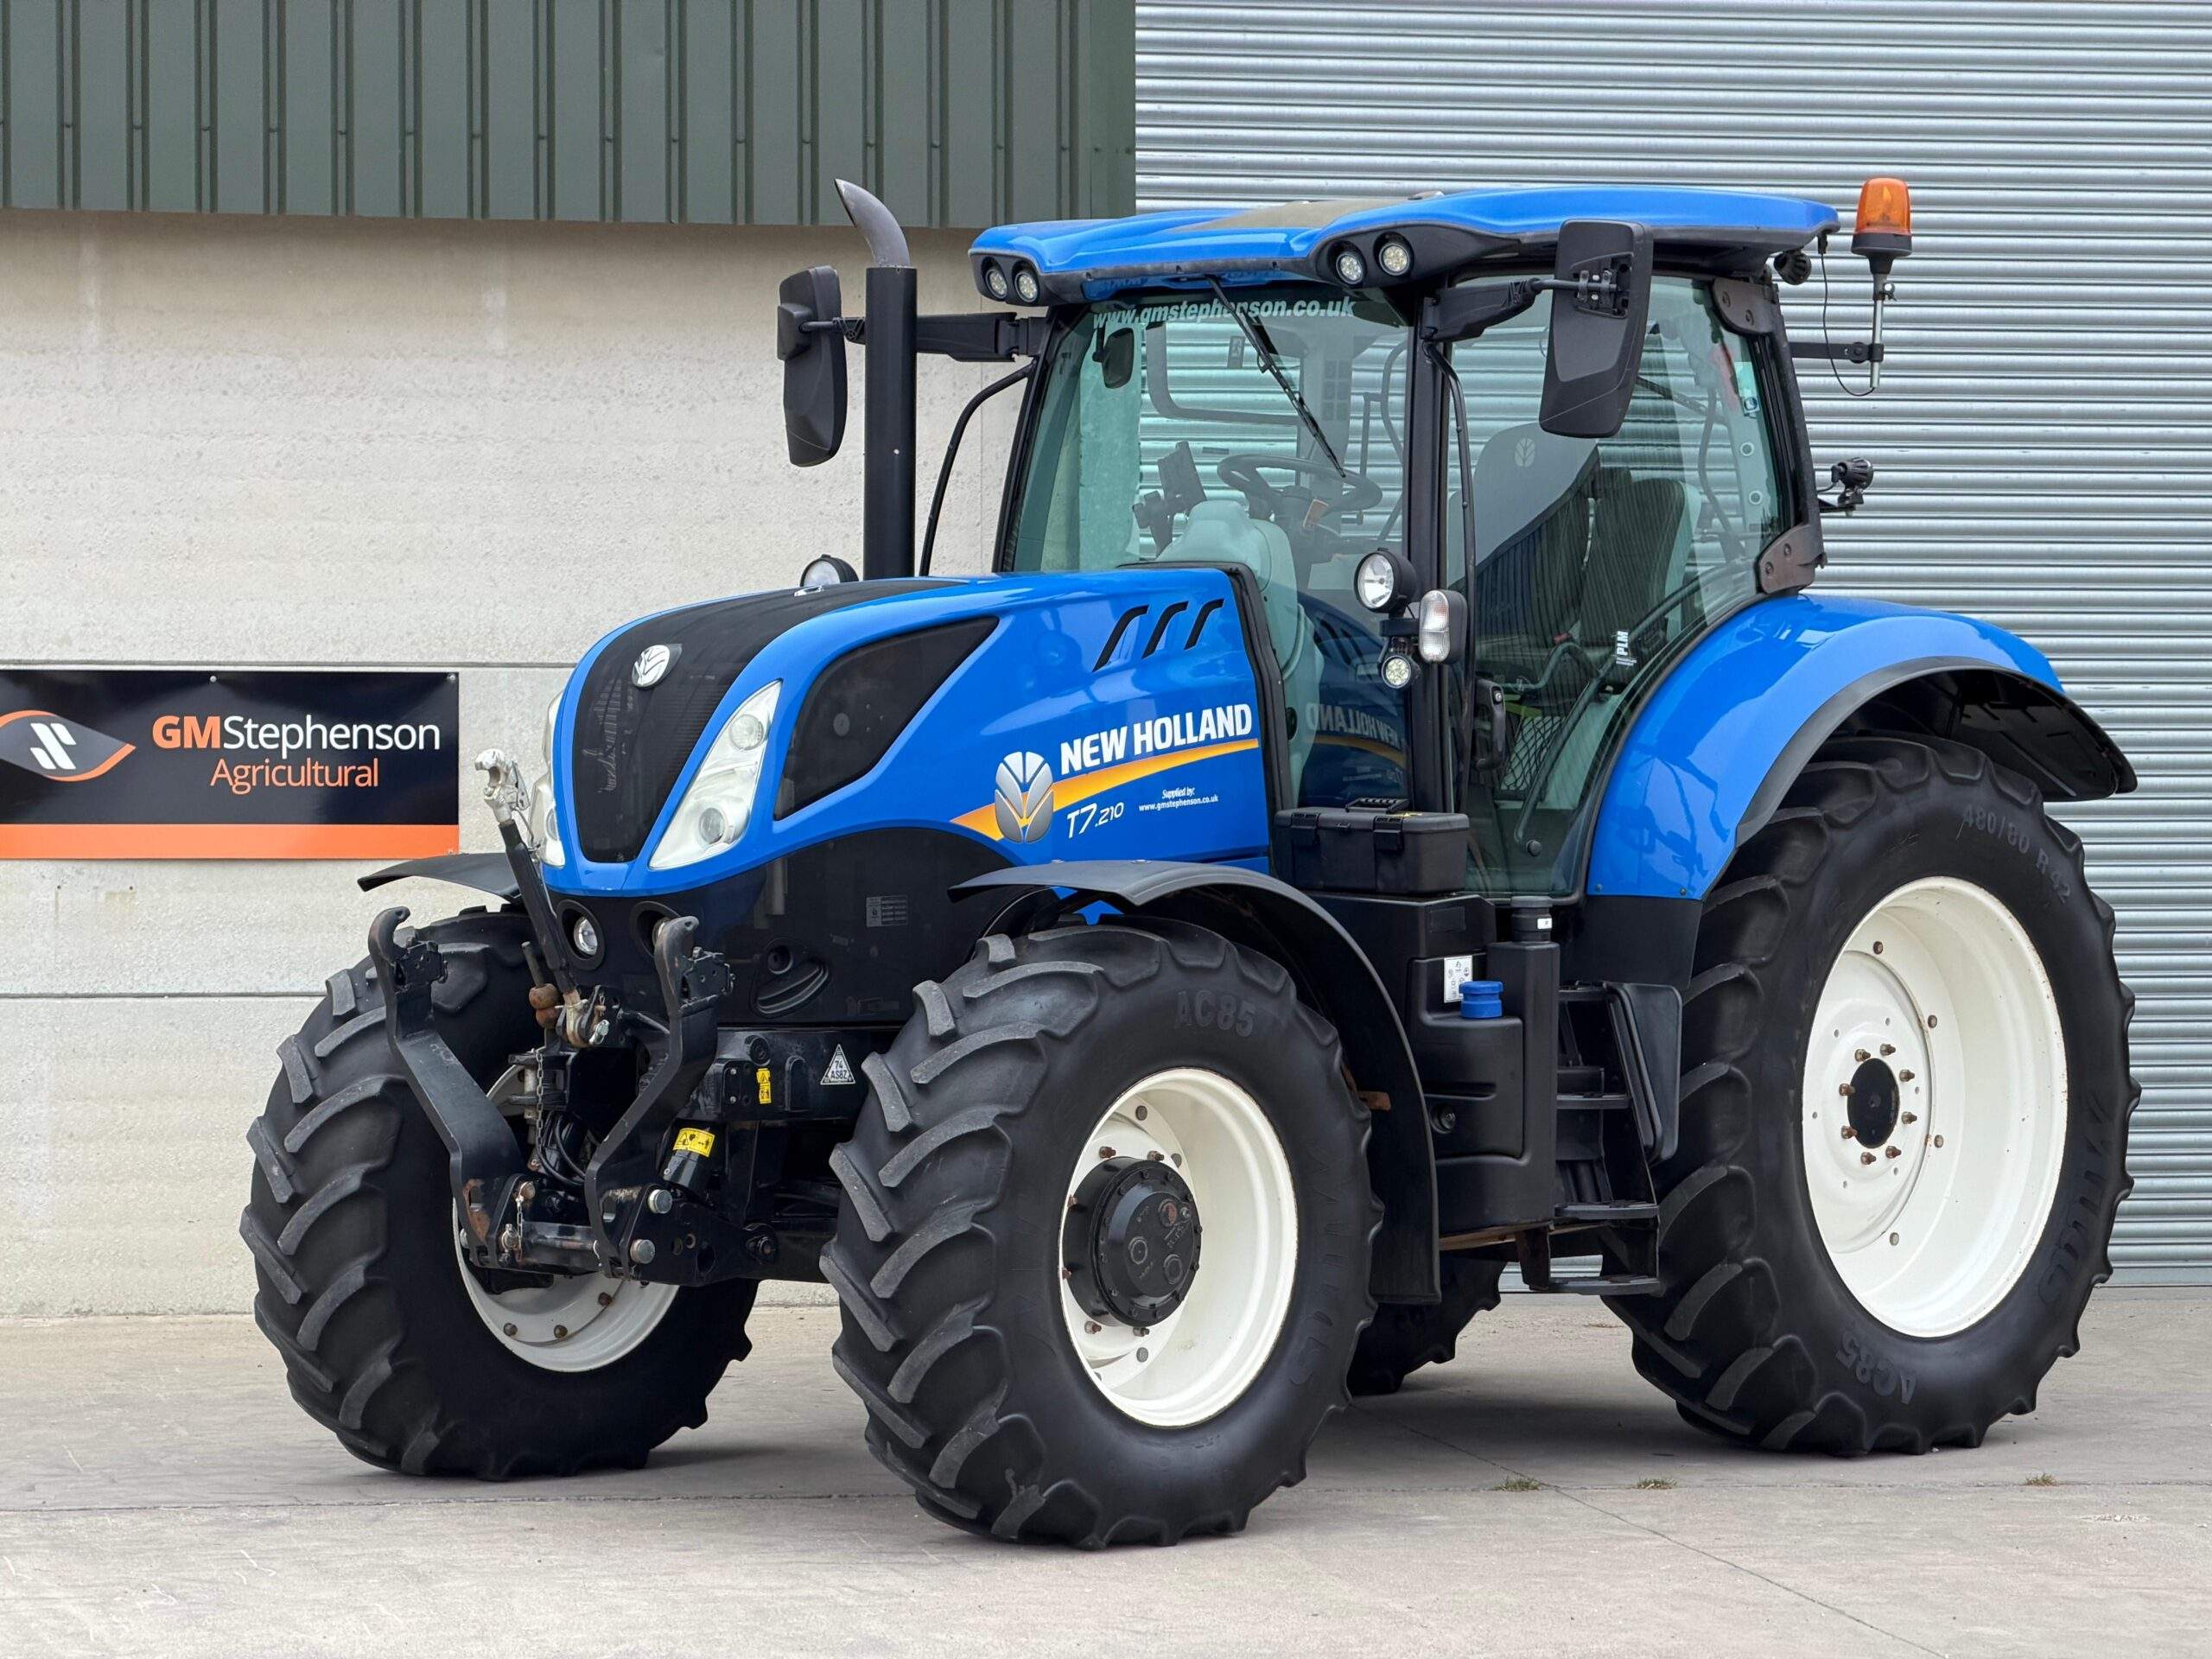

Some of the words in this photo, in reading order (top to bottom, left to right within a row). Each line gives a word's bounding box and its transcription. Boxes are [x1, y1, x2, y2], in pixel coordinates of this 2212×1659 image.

[152, 715, 441, 759] GMStephenson
[1060, 726, 1128, 775] NEW
[1134, 703, 1253, 756] HOLLAND
[210, 758, 378, 795] Agricultural
[1066, 801, 1124, 839] T7.210
[1138, 793, 1219, 812] www.gmstephenson.co.uk
[1174, 990, 1255, 1037] AC85
[835, 1060, 843, 1070] 74
[1835, 1329, 1917, 1406] AC85
